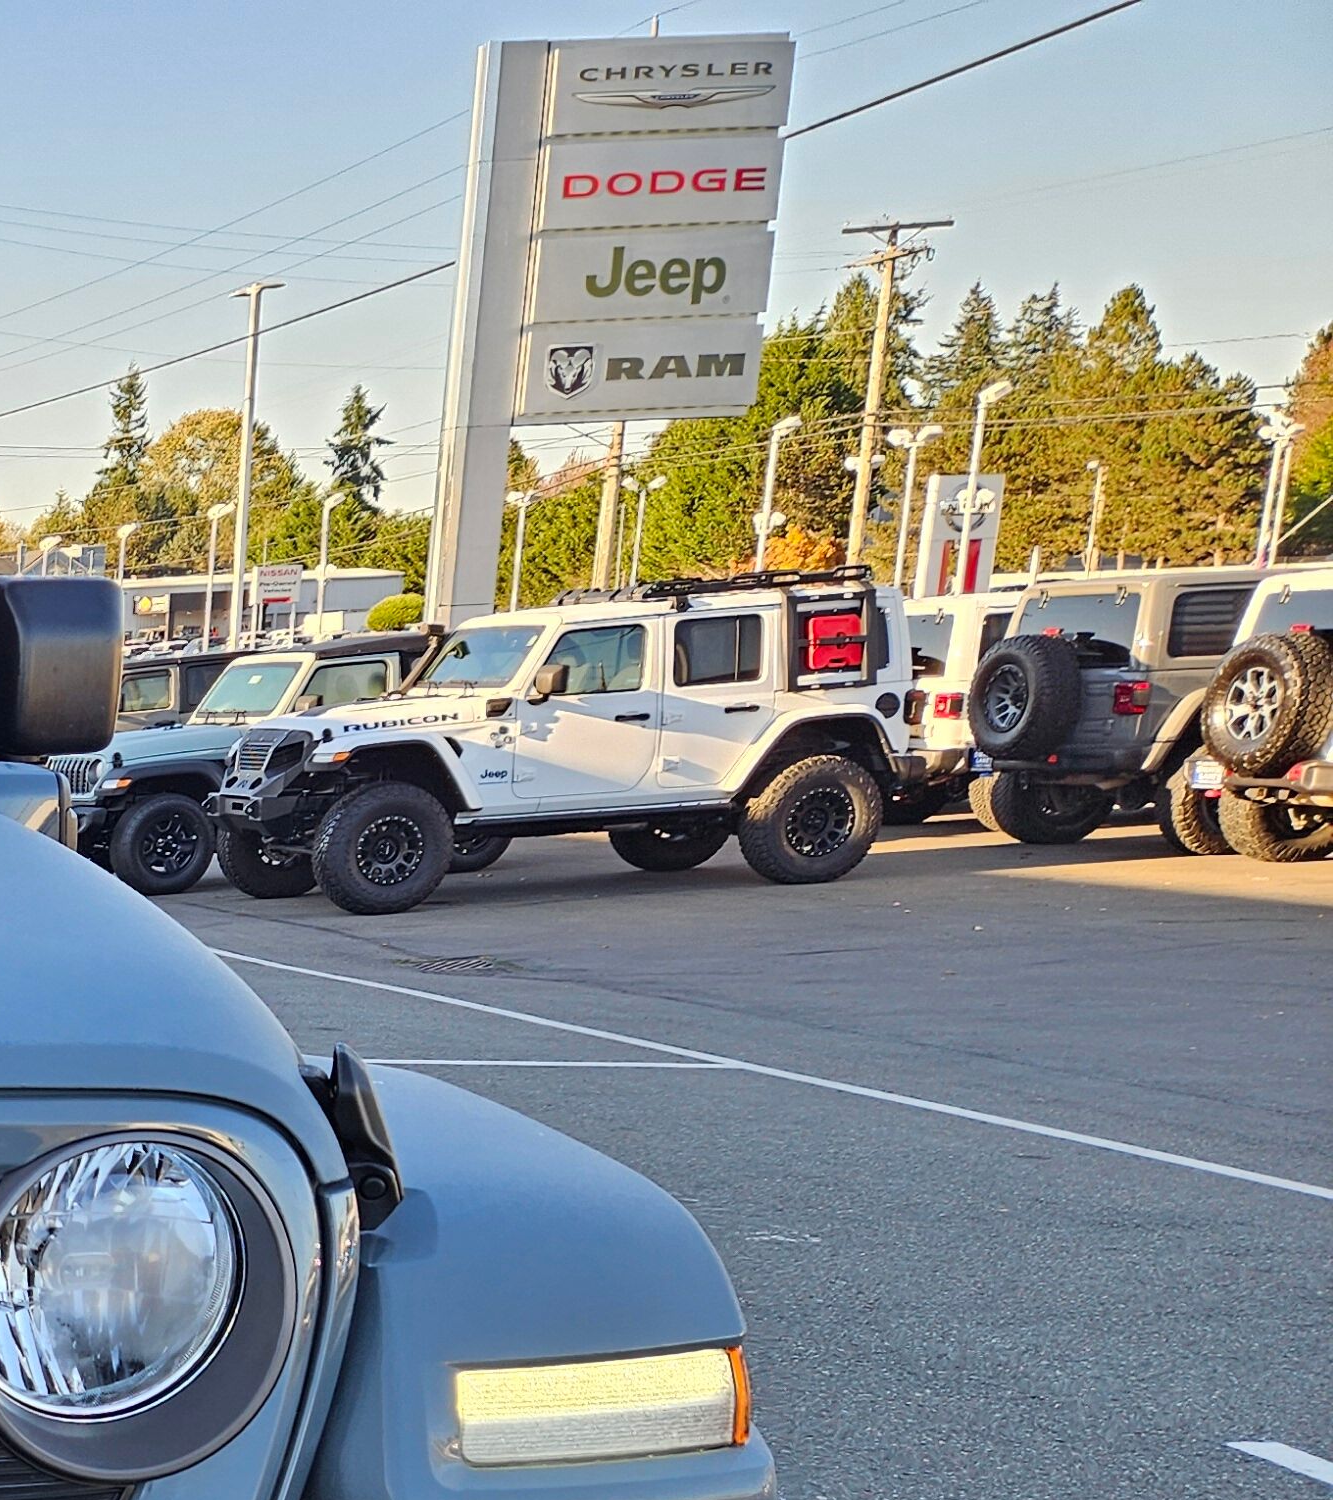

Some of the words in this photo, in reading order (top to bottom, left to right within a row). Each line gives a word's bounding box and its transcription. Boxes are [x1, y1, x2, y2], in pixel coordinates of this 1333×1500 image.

[578, 60, 774, 83] CHRYSLER
[562, 167, 768, 199] DODGE
[585, 246, 727, 305] Jeep
[605, 352, 747, 382] RAM
[259, 569, 298, 577] NISSAN
[343, 713, 459, 733] RUBICON
[480, 769, 508, 779] Jeep
